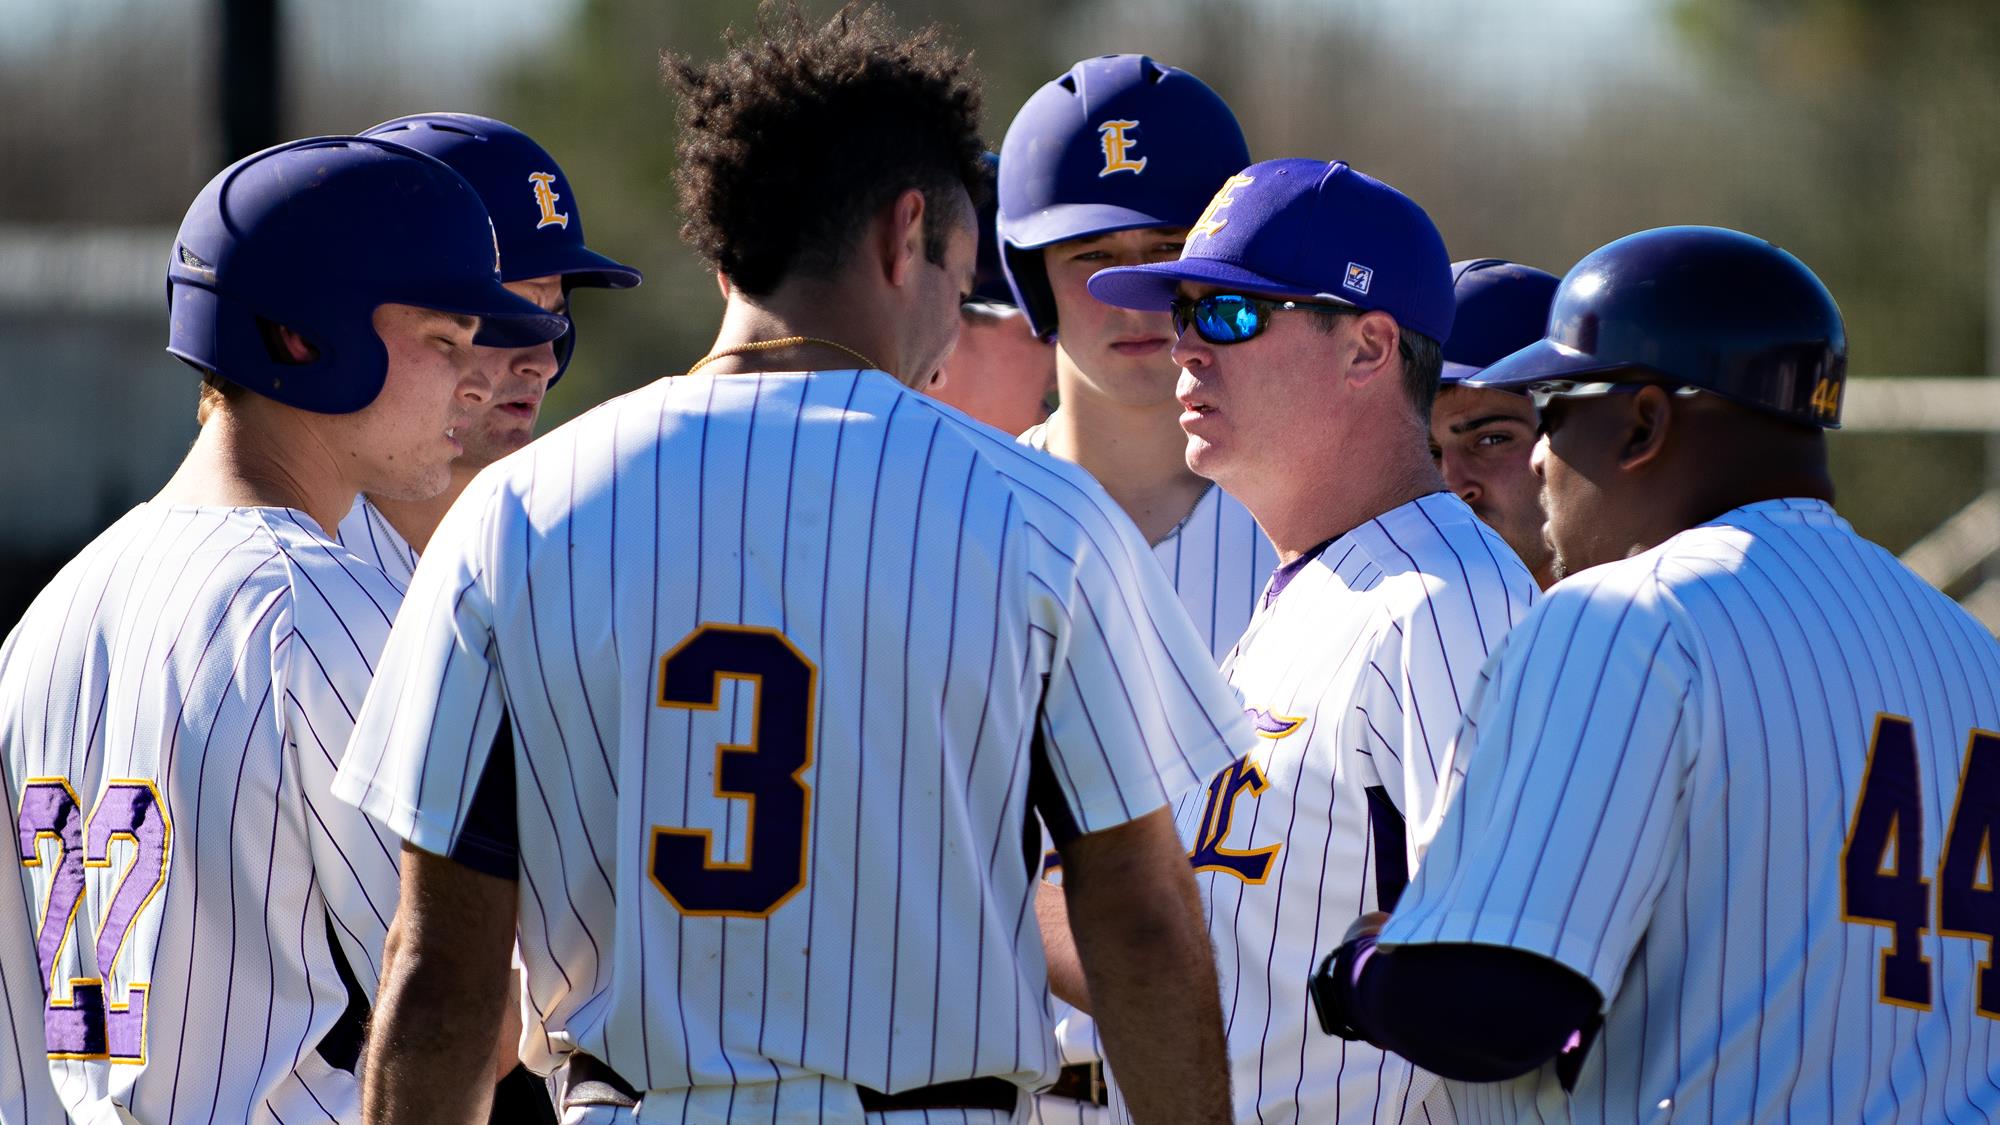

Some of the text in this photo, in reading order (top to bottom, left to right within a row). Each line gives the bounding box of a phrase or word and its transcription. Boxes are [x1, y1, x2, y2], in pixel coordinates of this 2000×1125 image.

[528, 171, 569, 230] E
[1098, 118, 1148, 178] E
[1810, 377, 1840, 417] 44
[648, 621, 818, 919] 3
[17, 775, 172, 1065] 22
[1839, 711, 2000, 1021] 44
